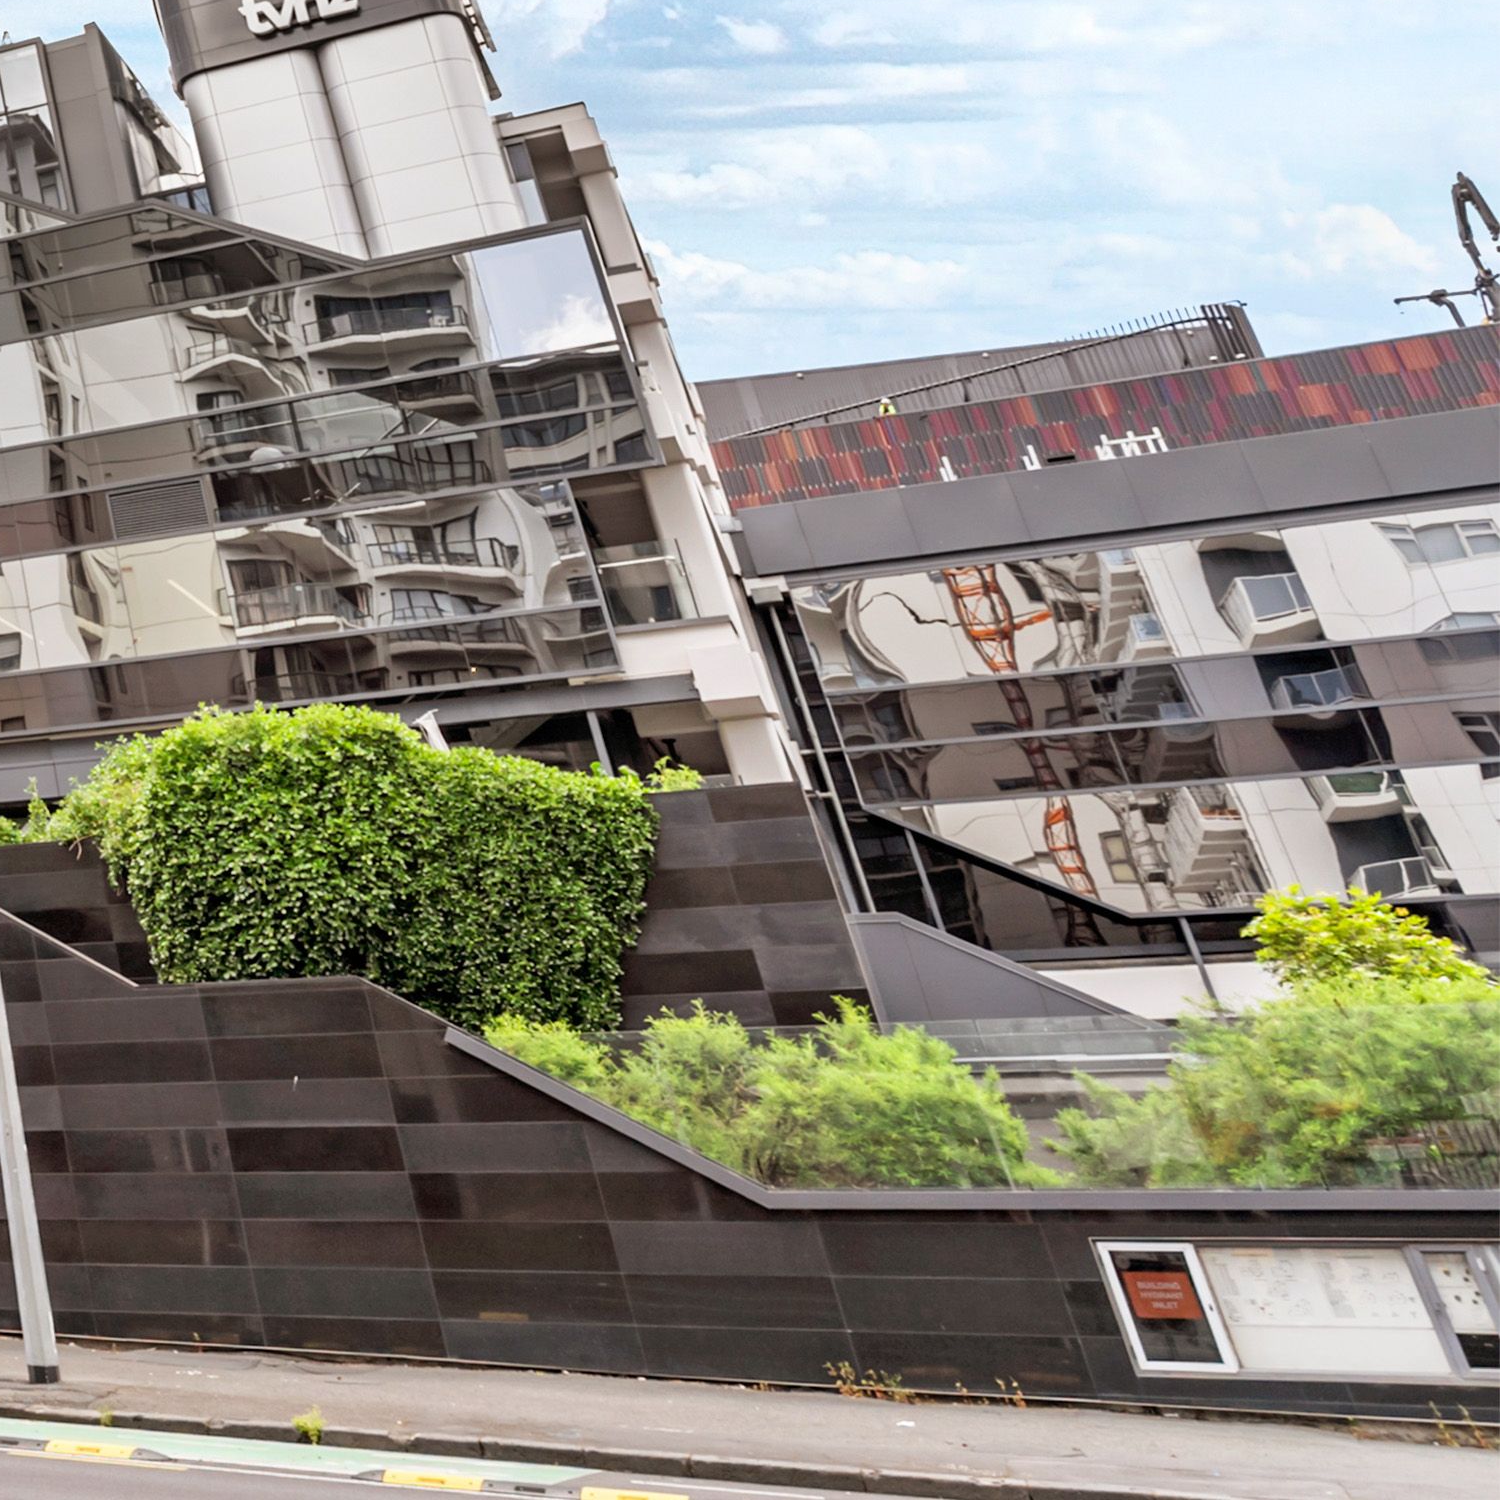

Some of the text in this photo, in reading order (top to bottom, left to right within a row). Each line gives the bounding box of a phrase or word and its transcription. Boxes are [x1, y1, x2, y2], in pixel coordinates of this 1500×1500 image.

[1136, 1282, 1181, 1290] BUILDING
[1140, 1292, 1184, 1300] HYDRANT
[1151, 1301, 1178, 1310] INLET
